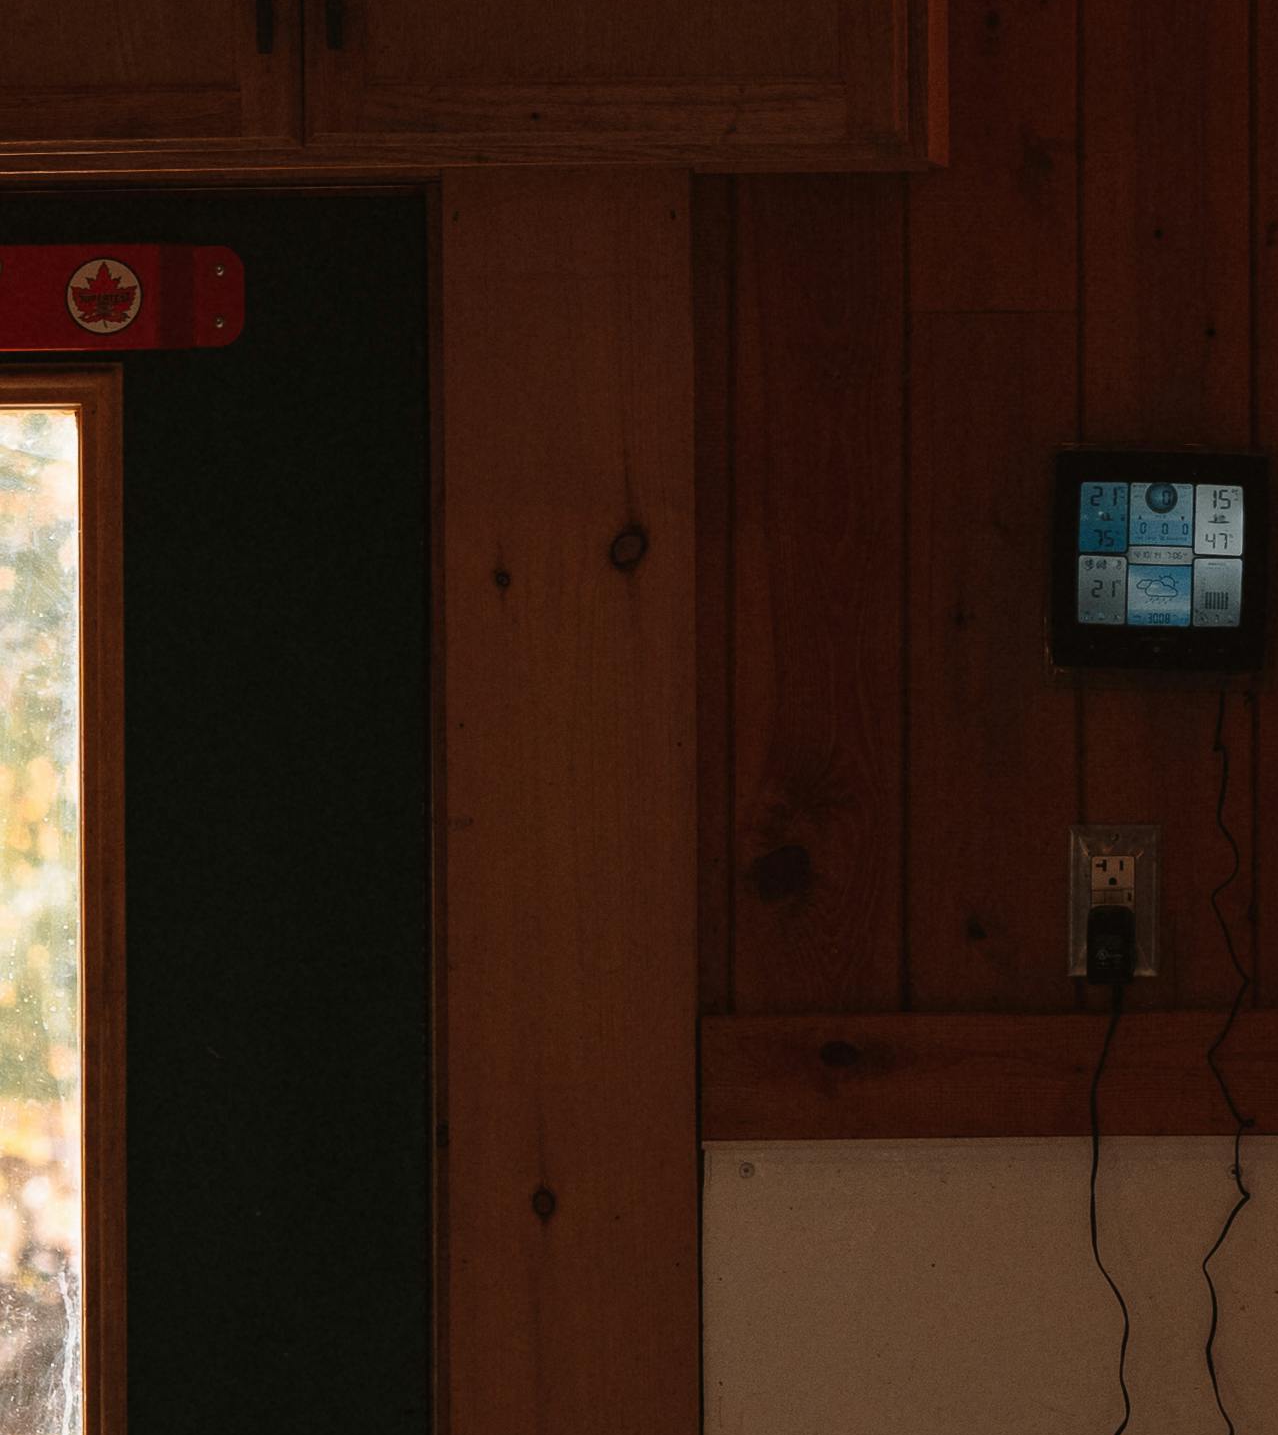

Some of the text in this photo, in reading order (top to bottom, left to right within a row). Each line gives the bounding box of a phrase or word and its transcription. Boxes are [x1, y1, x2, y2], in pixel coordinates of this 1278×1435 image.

[1211, 489, 1232, 510] 15
[1093, 529, 1115, 547] 75
[1204, 533, 1229, 550] 47
[1091, 579, 1116, 598] 21
